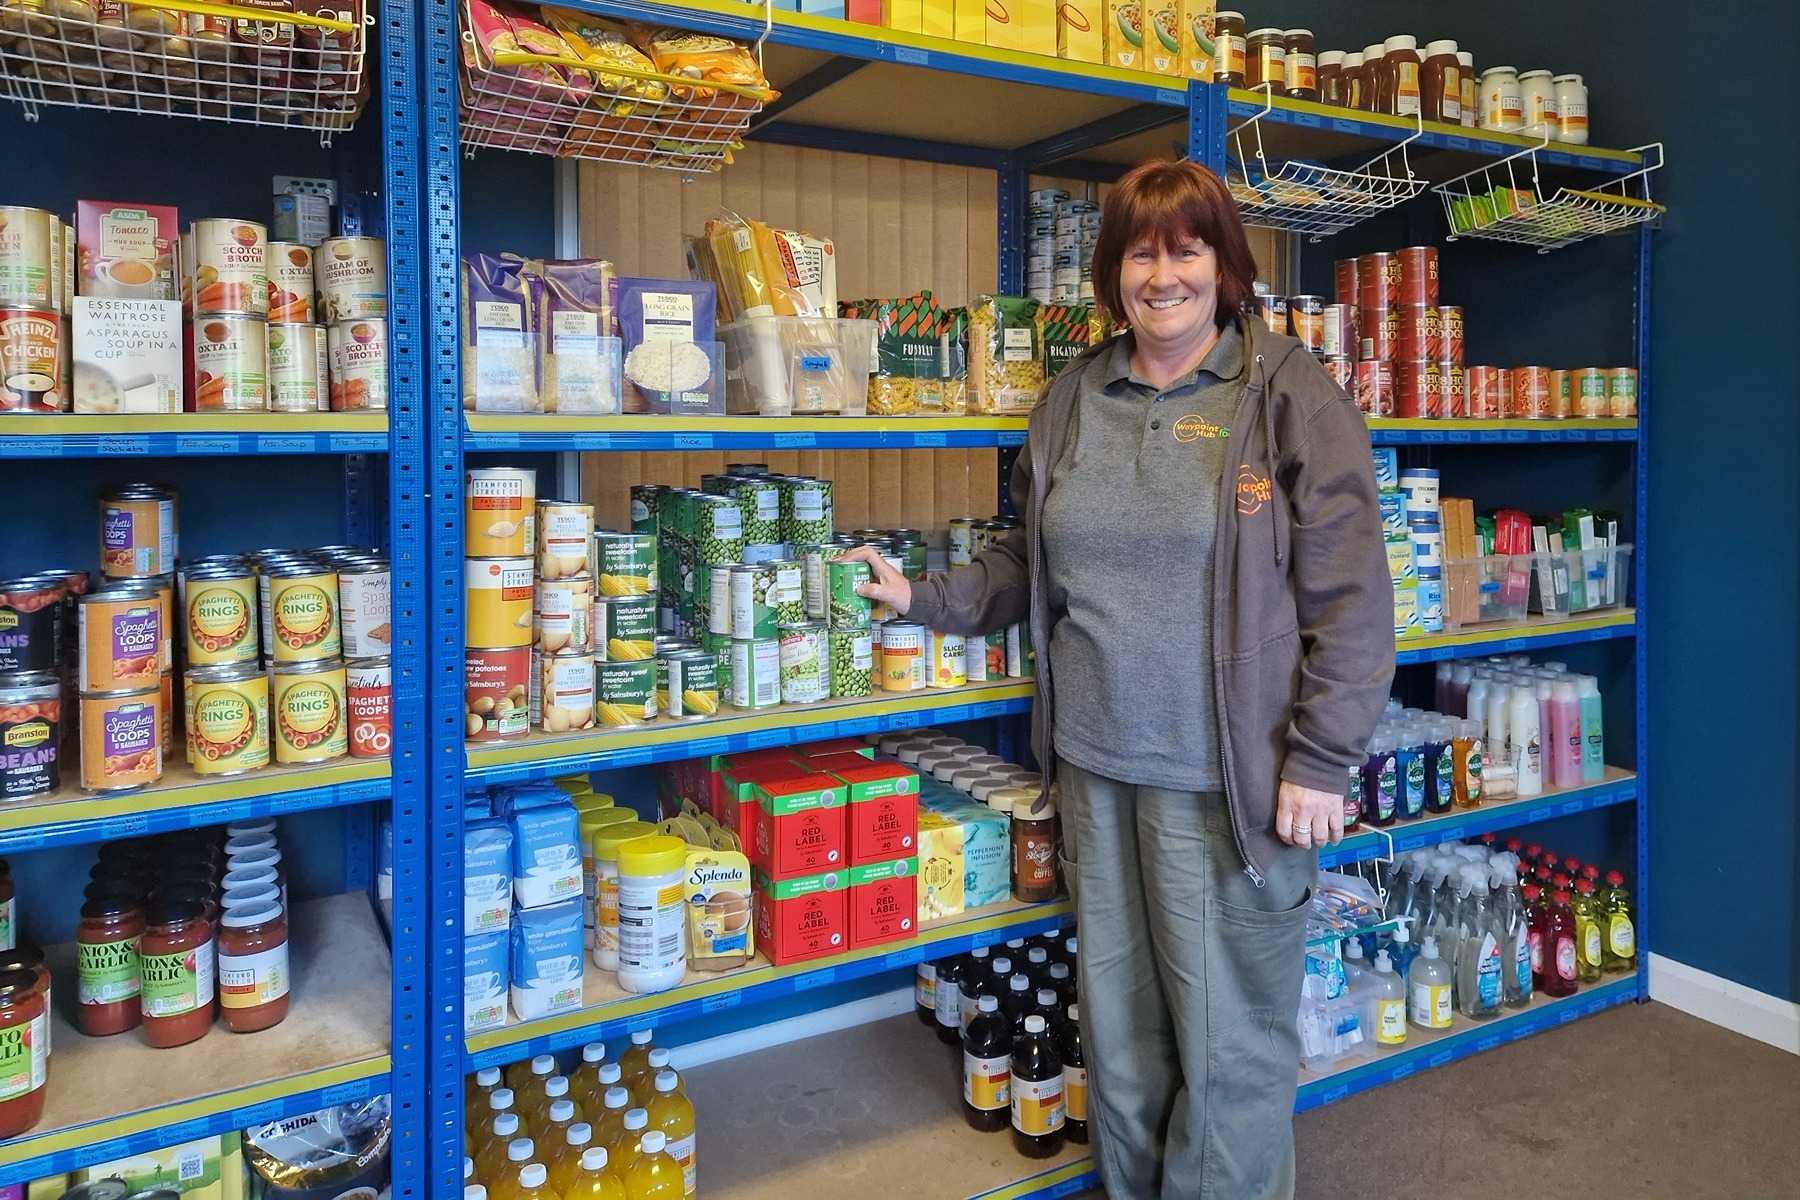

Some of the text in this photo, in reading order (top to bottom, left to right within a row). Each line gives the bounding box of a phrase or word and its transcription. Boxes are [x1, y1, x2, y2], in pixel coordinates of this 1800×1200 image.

[1122, 54, 1130, 62] 12
[1157, 59, 1165, 67] 12
[117, 212, 141, 220] ASDA
[110, 225, 149, 235] Tomato
[223, 247, 263, 255] SCOTCH
[228, 255, 262, 263] BROTH
[325, 261, 354, 272] CREAM
[1429, 261, 1435, 270] 8
[1381, 267, 1388, 275] 8
[88, 301, 166, 312] ESSENTIAL
[89, 311, 166, 322] WAITROSE
[1379, 322, 1387, 330] 8
[1416, 318, 1423, 327] 8
[10, 321, 52, 338] HEINZ
[86, 329, 169, 338] ASPARAGUS
[108, 340, 144, 349] SOUP
[149, 341, 163, 349] IN
[346, 343, 384, 352] SCOTCH
[903, 342, 933, 356] FUSILLI
[4, 345, 55, 358] CHICKEN
[95, 350, 123, 359] CUP
[348, 351, 381, 361] BROTH
[1417, 374, 1426, 384] 8
[1441, 376, 1448, 385] 8
[1177, 424, 1219, 432] Waypoint
[918, 435, 939, 443] Pasta
[1196, 430, 1216, 439] Hub
[205, 439, 232, 451] Soup
[282, 440, 307, 449] Soup
[355, 438, 380, 447] Soup
[681, 436, 702, 445] Rice
[362, 579, 388, 589] Simply
[197, 597, 240, 606] SPAGHETTI
[281, 594, 323, 603] SPAGHETTI
[199, 605, 240, 618] RINGS
[283, 602, 323, 614] RINGS
[115, 619, 158, 636] Spaghetti
[625, 627, 654, 635] Sainsbury's
[120, 633, 155, 646] LOOPS
[287, 690, 330, 700] SPAGHETTI
[199, 700, 244, 711] SPAGHETTI
[288, 700, 329, 712] RINGS
[354, 705, 389, 716] LOOPS
[201, 710, 243, 722] RINGS
[107, 714, 154, 733] Spaghetti
[8, 728, 48, 742] Branston
[111, 728, 150, 743] LOOPS
[0, 747, 57, 769] BEANS
[1468, 762, 1482, 770] RADOX
[523, 815, 572, 830] white granulated
[878, 814, 895, 823] RED
[872, 821, 901, 832] LABEL
[801, 827, 821, 837] RED
[795, 834, 826, 846] LABEL
[967, 845, 1004, 855] PEPPERMINT
[970, 852, 1001, 861] INFUSION
[689, 867, 743, 885] Splenda
[876, 896, 894, 905] RED
[870, 904, 900, 915] LABEL
[804, 911, 823, 921] RED
[798, 918, 830, 931] LABEL
[528, 925, 577, 940] white granulated
[536, 941, 567, 952] Sainsbury's
[557, 1034, 586, 1045] Sugar
[482, 1051, 512, 1062] Sugar
